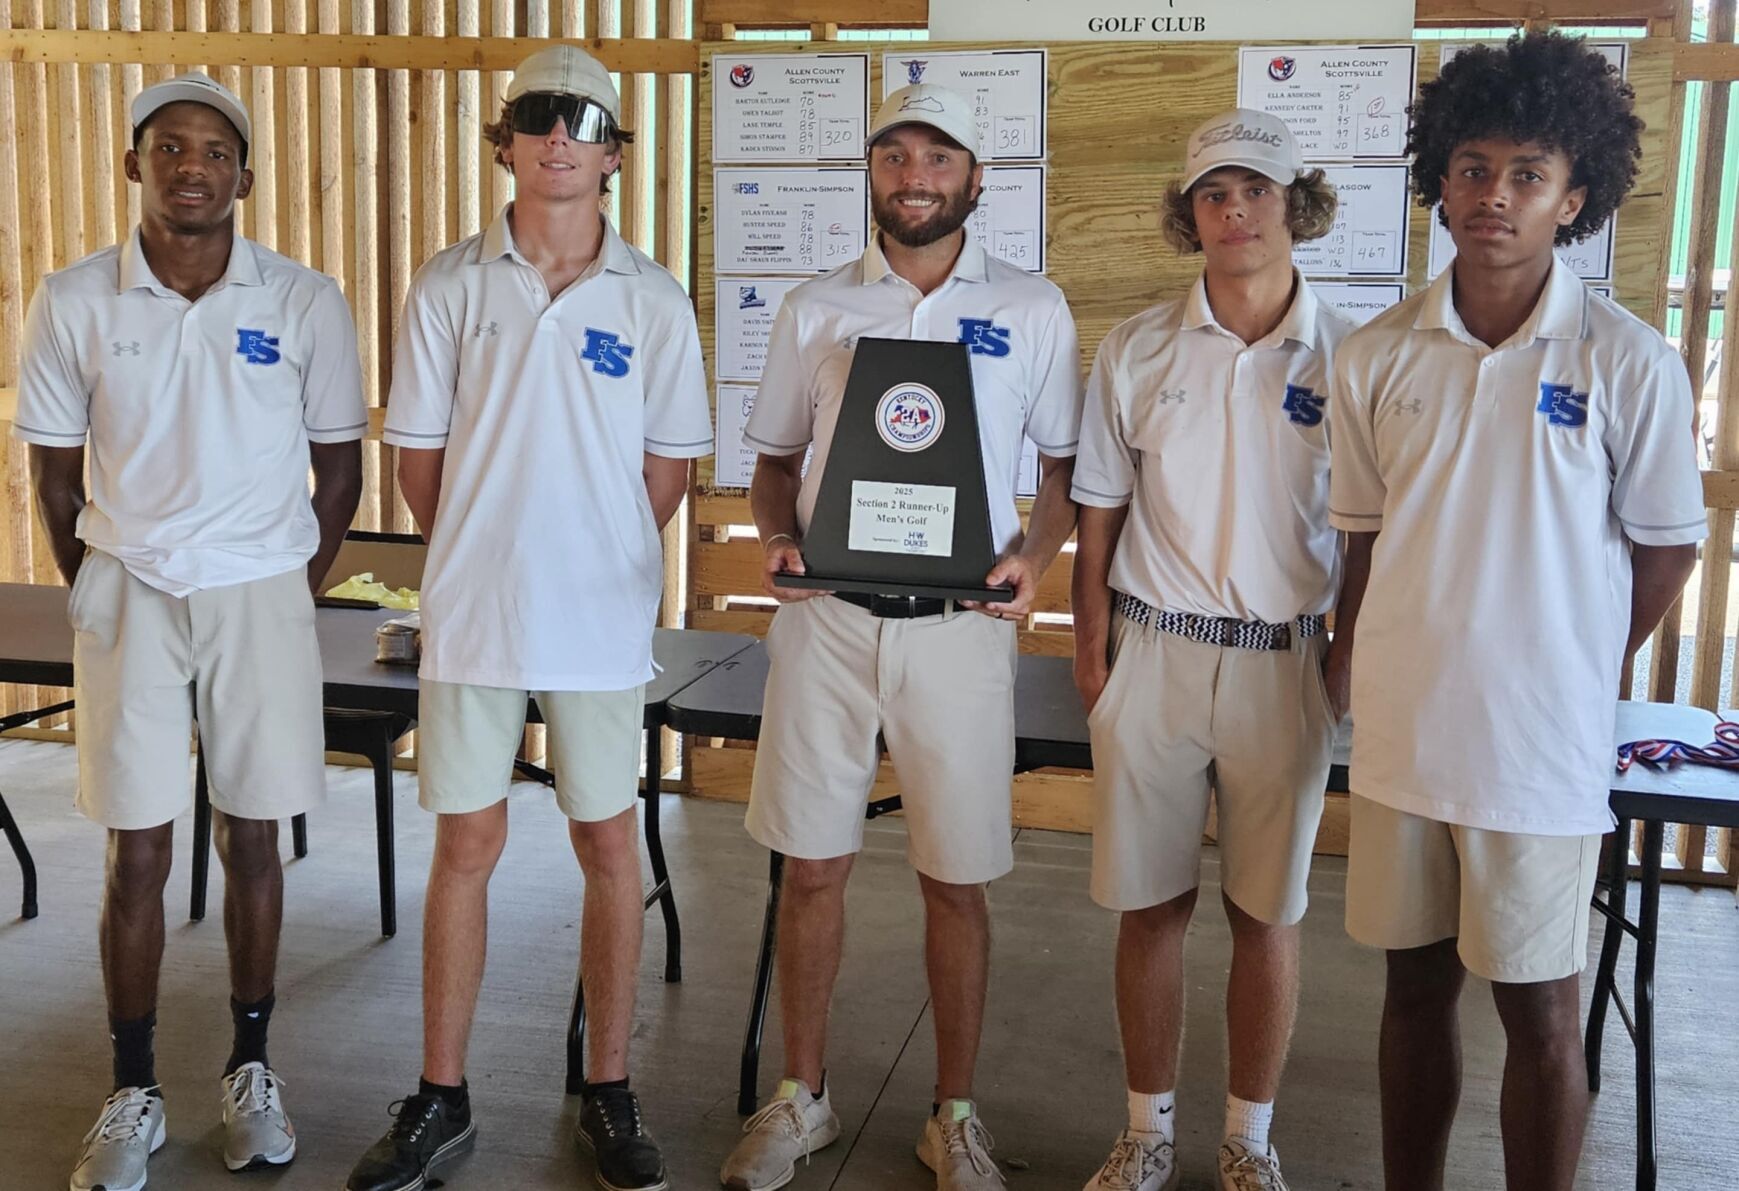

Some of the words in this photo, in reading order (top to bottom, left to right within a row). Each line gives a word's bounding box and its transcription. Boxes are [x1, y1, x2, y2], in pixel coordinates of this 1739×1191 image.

[1088, 17, 1146, 32] GOLF
[1151, 16, 1206, 32] CLUB
[812, 67, 845, 75] COUNTY
[1320, 60, 1350, 68] ALLEN
[1352, 59, 1389, 67] COUNTY
[823, 130, 852, 146] 320
[1000, 129, 1026, 149] 381
[1363, 124, 1389, 141] 368
[739, 183, 759, 195] FSHS
[989, 184, 1023, 192] COUNTY
[826, 244, 850, 256] 315
[999, 243, 1028, 259] 425
[1358, 247, 1386, 260] 467
[957, 317, 1011, 358] FS
[236, 328, 281, 365] FS
[580, 327, 634, 378] FS
[1282, 383, 1328, 427] FS
[1536, 381, 1589, 428] FS
[901, 406, 921, 423] 2A
[894, 487, 913, 495] 2025
[857, 498, 888, 508] Section
[891, 500, 897, 509] 2
[900, 501, 949, 515] Runner-Up
[876, 514, 904, 523] Men's
[907, 516, 928, 525] Golf
[903, 539, 928, 547] DUKES
